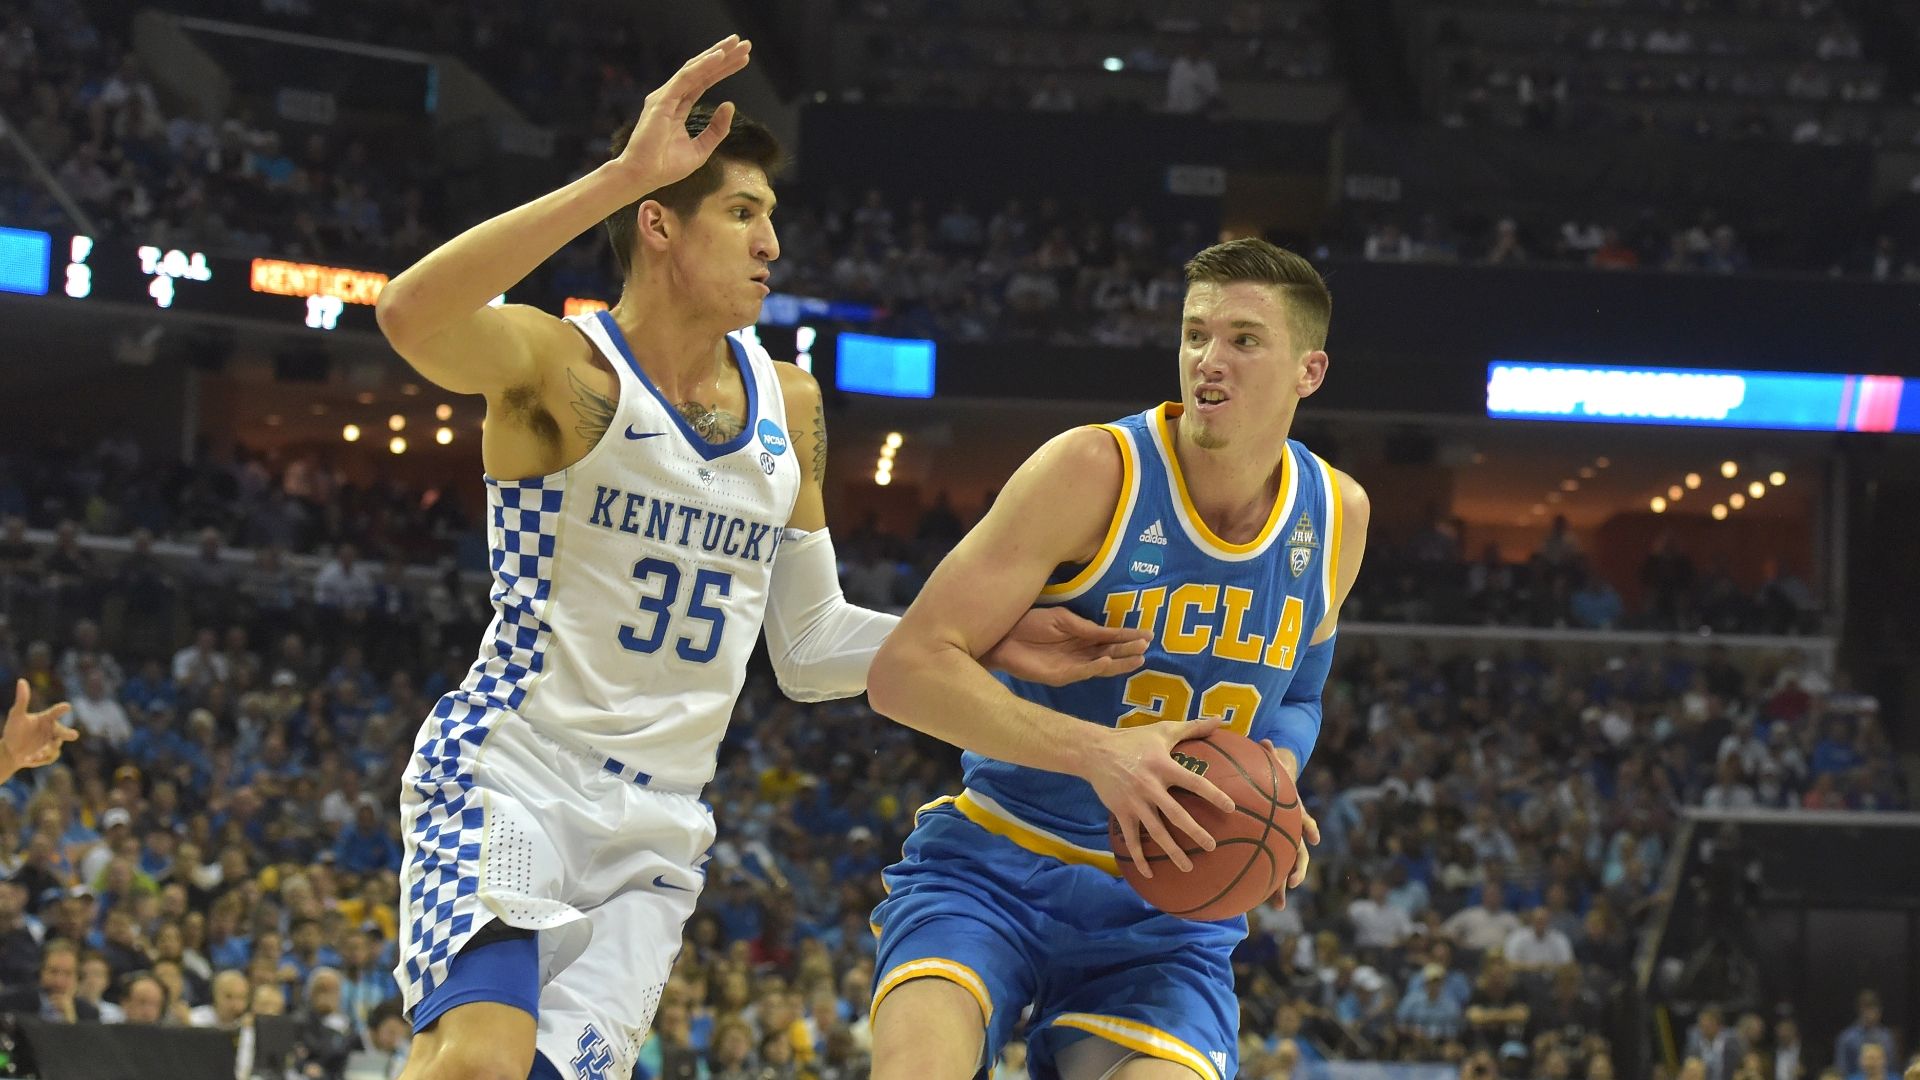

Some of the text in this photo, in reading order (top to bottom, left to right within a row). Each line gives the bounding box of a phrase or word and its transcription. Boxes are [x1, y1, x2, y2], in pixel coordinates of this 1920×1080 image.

[1139, 534, 1167, 546] adidas
[1131, 560, 1160, 576] NCAA
[617, 556, 733, 664] 35
[1103, 583, 1304, 671] UCLA
